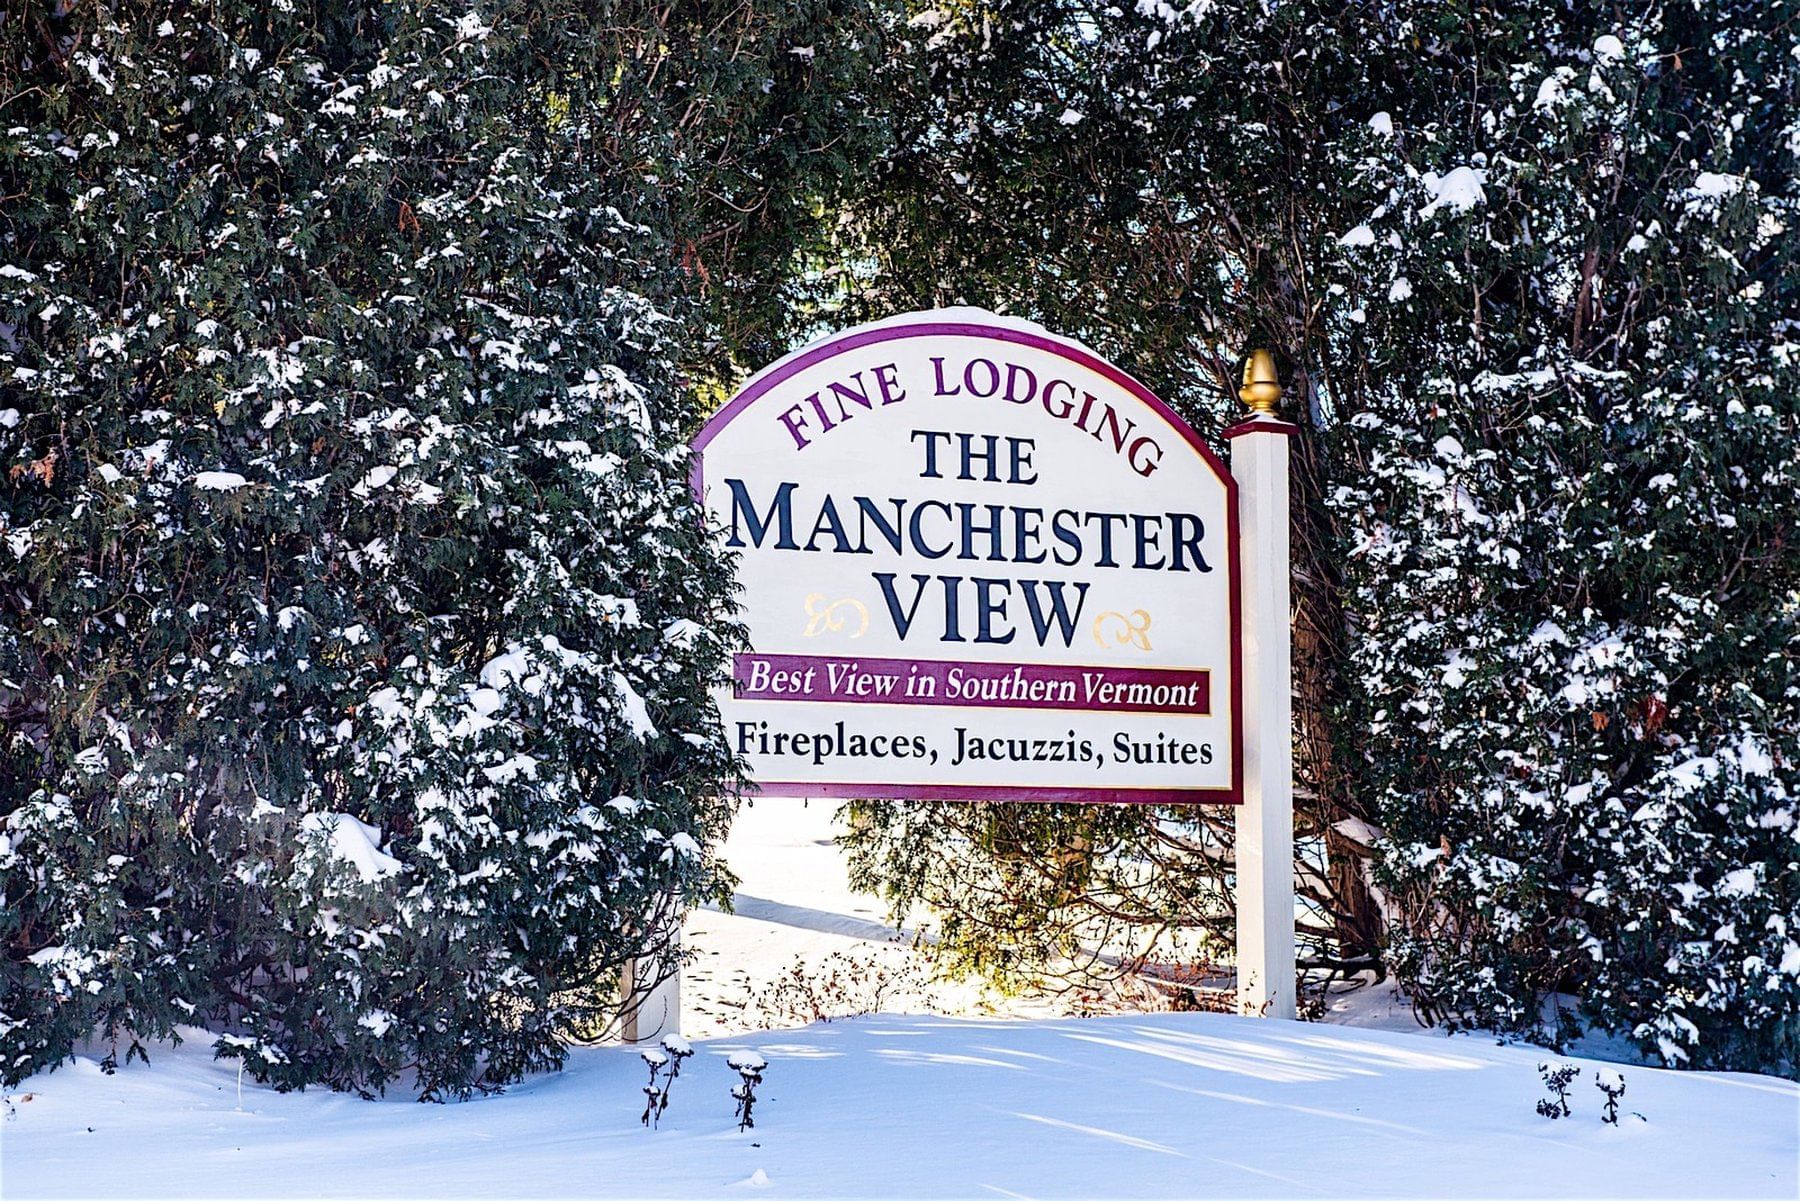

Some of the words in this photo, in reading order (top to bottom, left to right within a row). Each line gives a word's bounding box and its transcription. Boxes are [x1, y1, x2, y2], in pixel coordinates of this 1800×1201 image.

[777, 363, 906, 451] FINE
[929, 357, 1164, 478] LODGING
[910, 430, 1039, 485] THE
[723, 478, 1213, 574] MANCHESTER
[872, 572, 1091, 648] VIEW
[746, 660, 816, 694] Best
[826, 662, 899, 697] View
[905, 665, 936, 698] in
[944, 668, 1076, 703] Southern
[1082, 672, 1200, 707] Vermont
[735, 721, 939, 767] Fireplaces,
[951, 727, 1104, 770] Jacuzzis,
[1112, 732, 1214, 765] Suites
